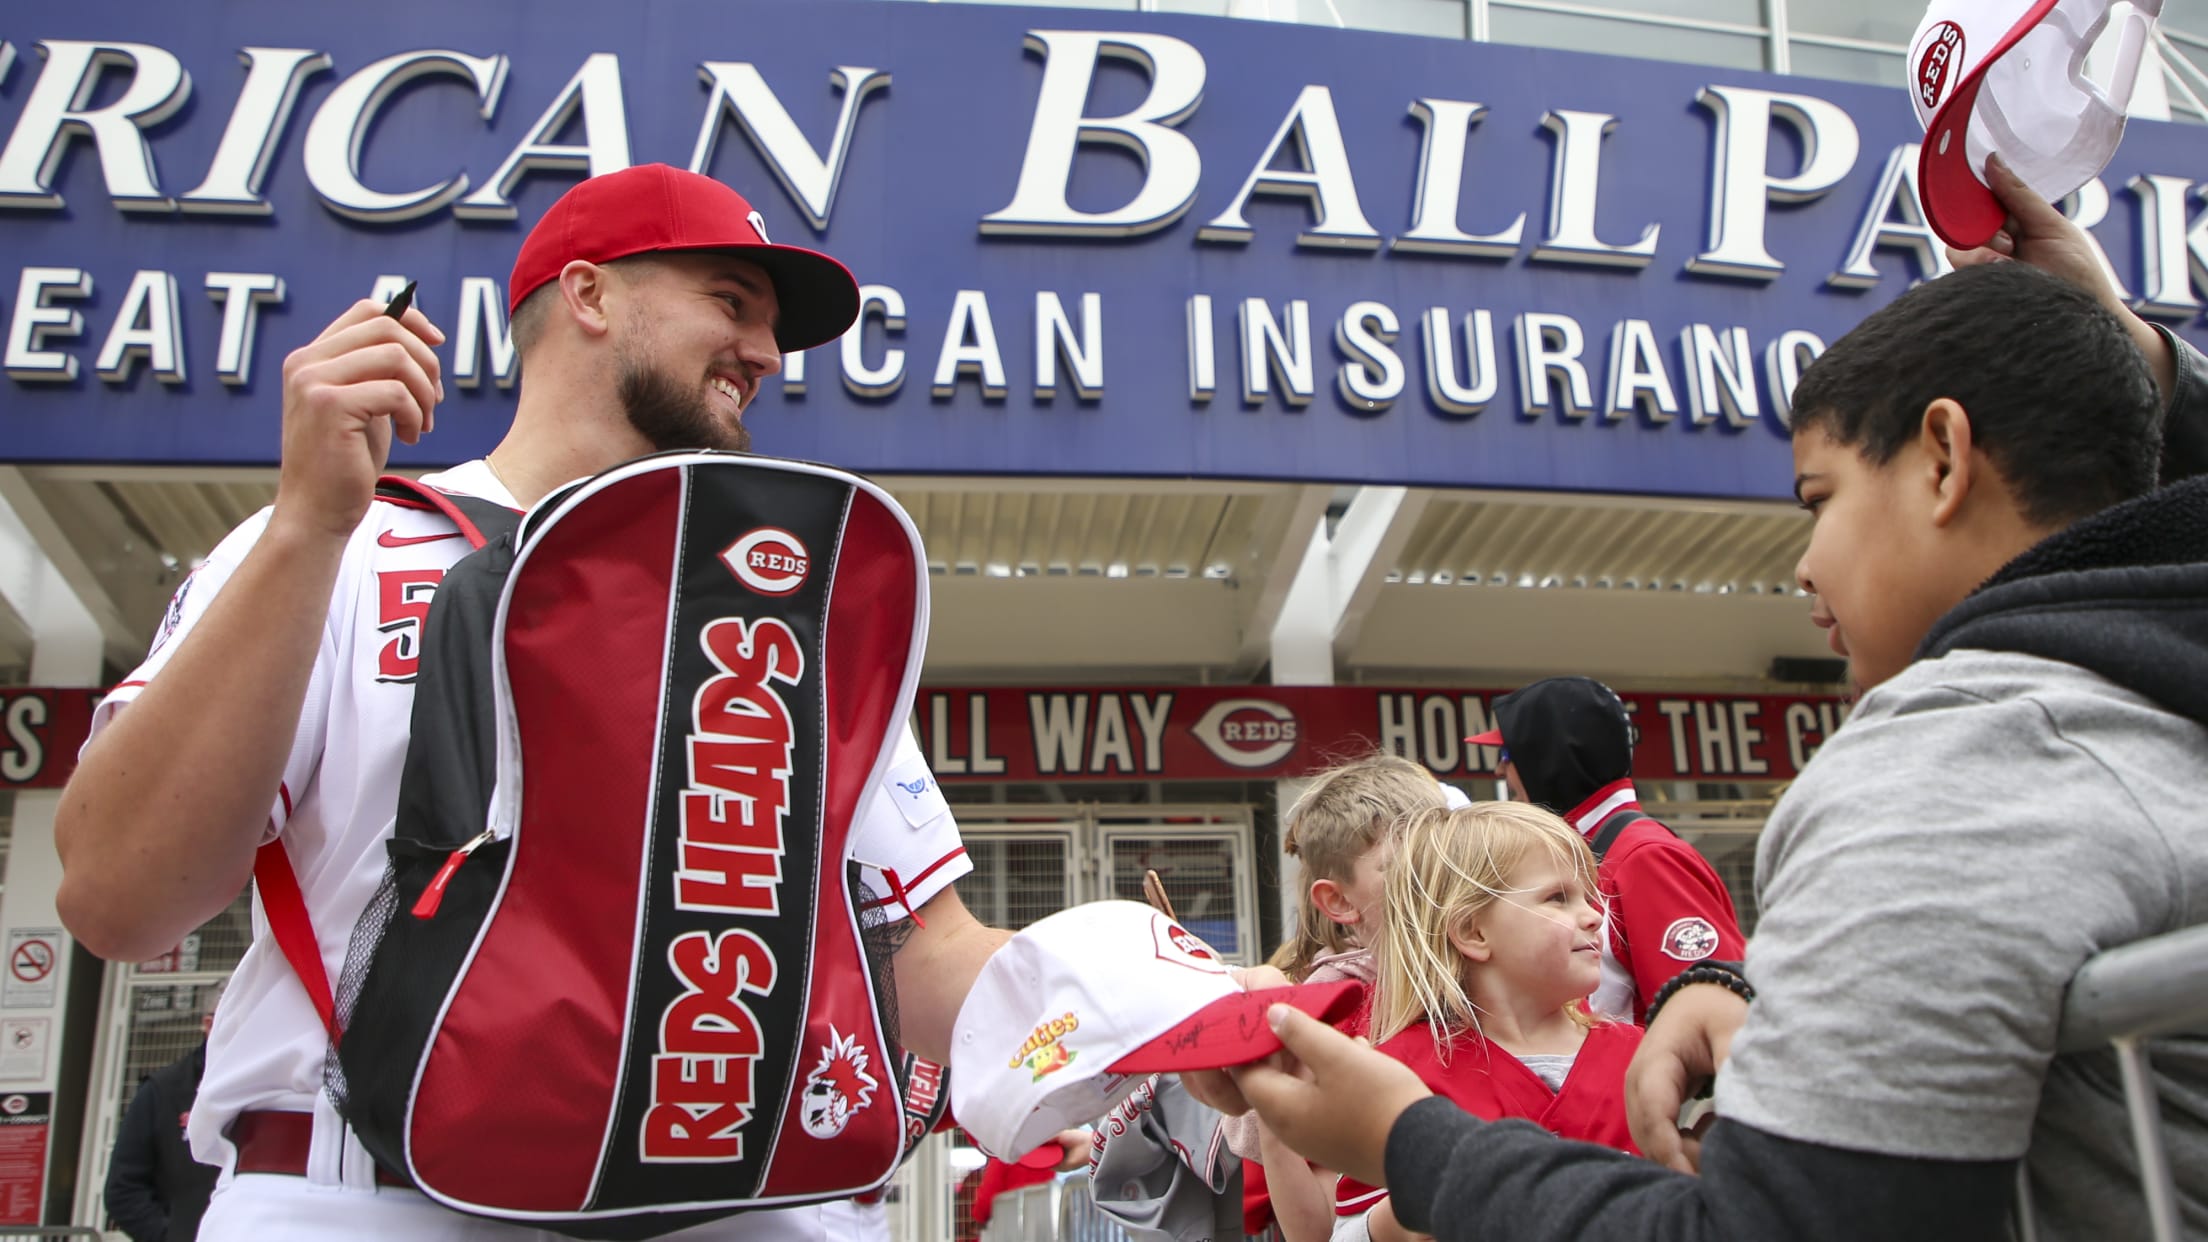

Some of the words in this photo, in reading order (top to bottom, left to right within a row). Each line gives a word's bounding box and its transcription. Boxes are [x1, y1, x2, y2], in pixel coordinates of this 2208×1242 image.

[1923, 24, 1959, 106] REDS
[0, 40, 892, 232] RICAN
[1187, 294, 1827, 430] INSURANC
[750, 551, 808, 575] REDS
[0, 695, 47, 782] S
[674, 616, 805, 916] HEADS
[908, 694, 1006, 773] LL
[1028, 694, 1173, 772] WAY
[1223, 721, 1297, 741] REDS
[1379, 694, 1501, 772] HOM
[1659, 701, 1768, 774] THE
[639, 927, 778, 1164] REDS
[1008, 1011, 1079, 1069] Cuties
